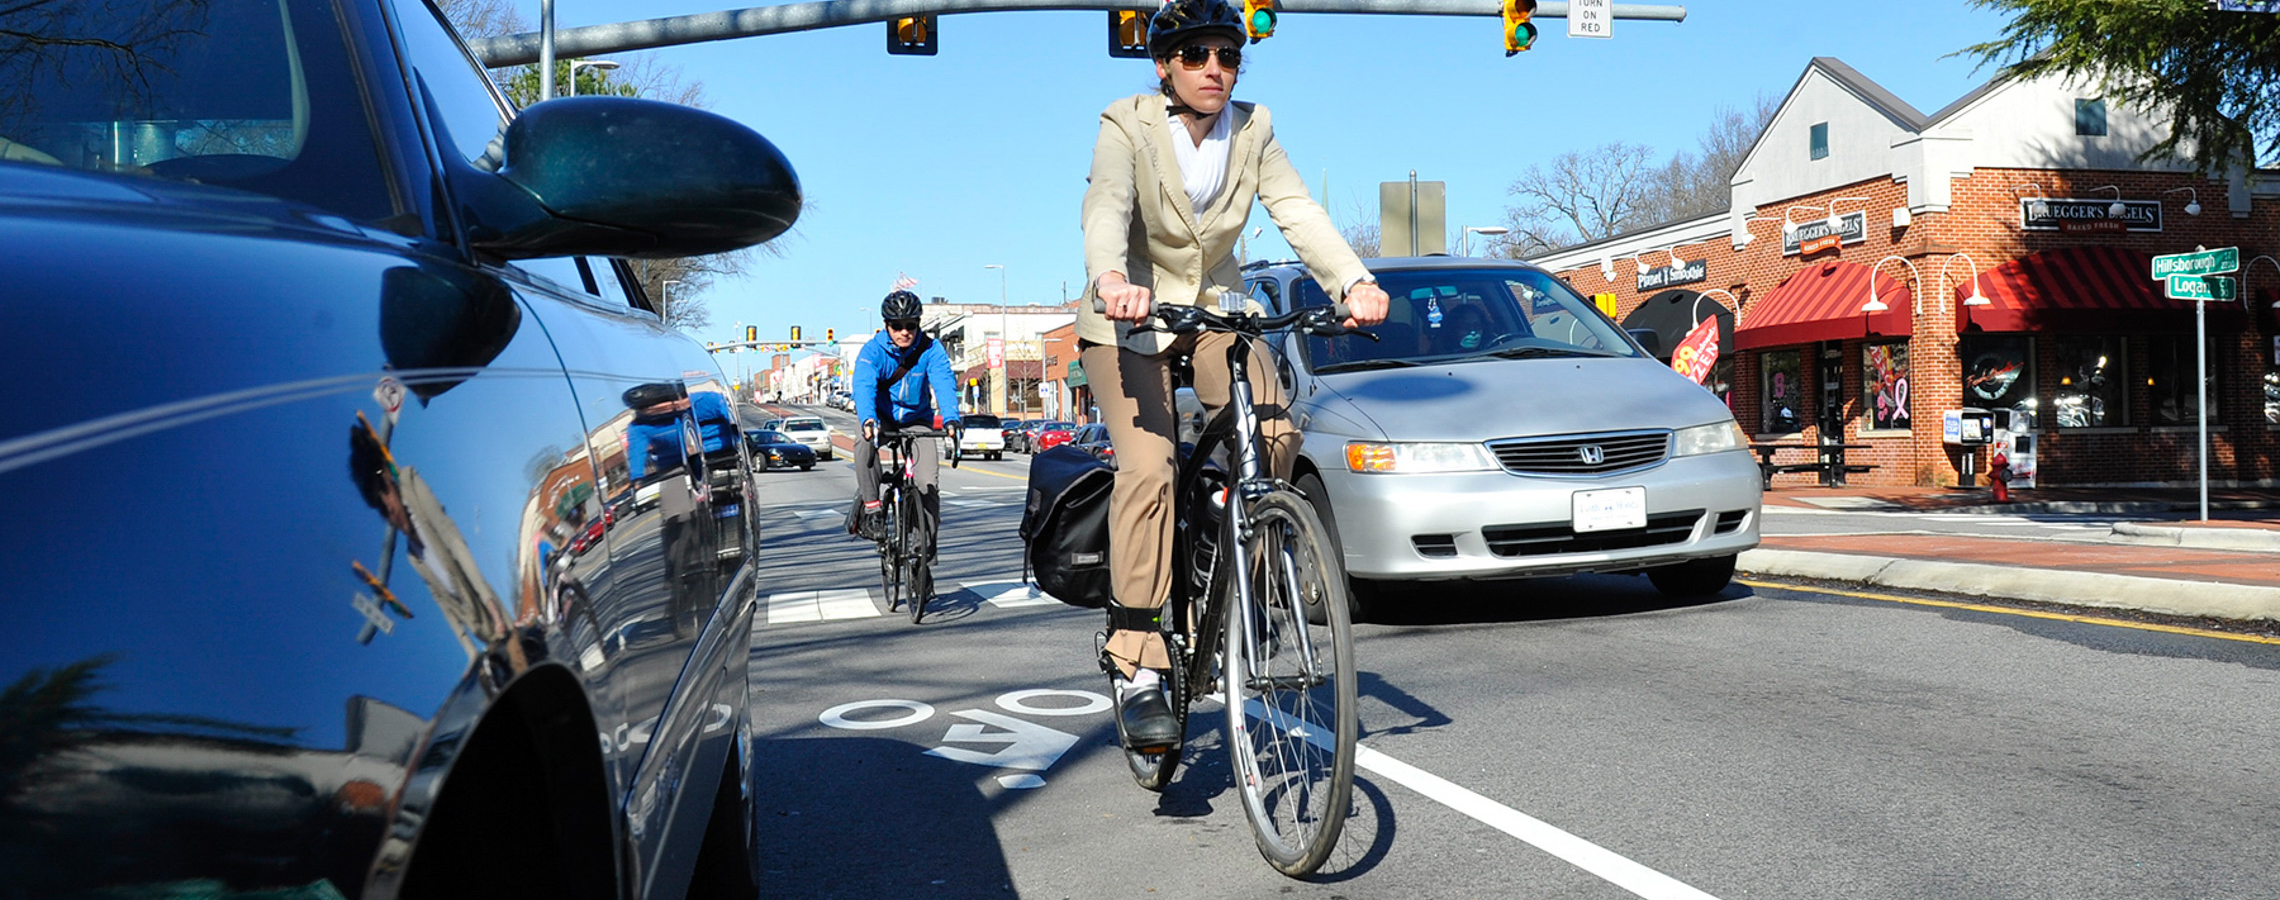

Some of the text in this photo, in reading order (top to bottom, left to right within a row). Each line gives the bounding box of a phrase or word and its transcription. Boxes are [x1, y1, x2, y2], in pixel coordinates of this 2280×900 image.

[1583, 10, 1597, 19] ON
[1581, 22, 1601, 32] RED
[2108, 206, 2154, 223] BGELS
[2094, 221, 2119, 229] FRESH
[2156, 254, 2215, 273] Hillsborough
[1670, 264, 1705, 282] Smoothie
[2174, 277, 2211, 297] Logan
